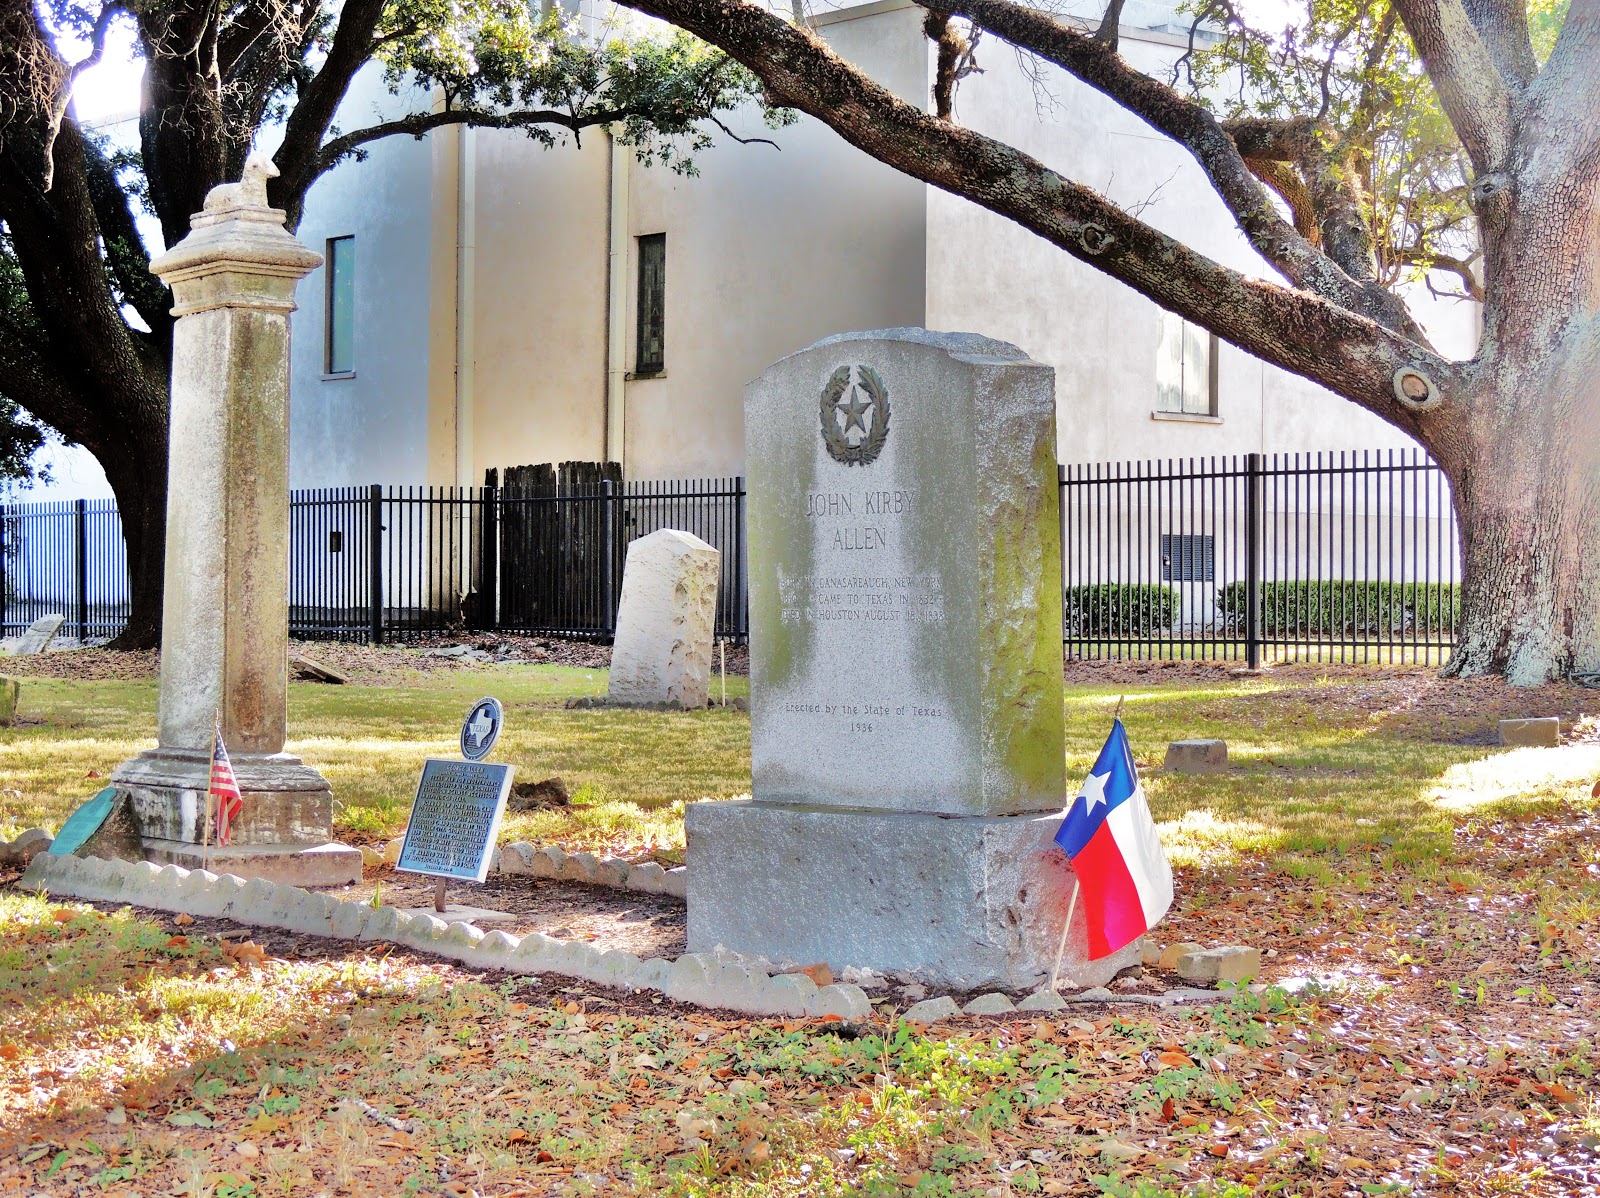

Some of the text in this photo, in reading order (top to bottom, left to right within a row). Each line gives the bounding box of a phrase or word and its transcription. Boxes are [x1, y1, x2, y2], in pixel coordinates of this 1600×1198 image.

[806, 490, 915, 517] JOHN KIRBY
[833, 527, 886, 550] ALLEN
[894, 577, 912, 588] NEW
[818, 594, 841, 605] CAME
[847, 594, 859, 605] TO
[865, 594, 893, 605] TEXAS
[899, 594, 909, 605] IN
[819, 610, 860, 621] HOUSTON
[864, 610, 900, 621] AUGUST
[785, 702, 942, 717] Erected by the State of Texas
[472, 724, 490, 733] TEXAS
[850, 722, 873, 733] 1936
[446, 764, 465, 772] GEORGE
